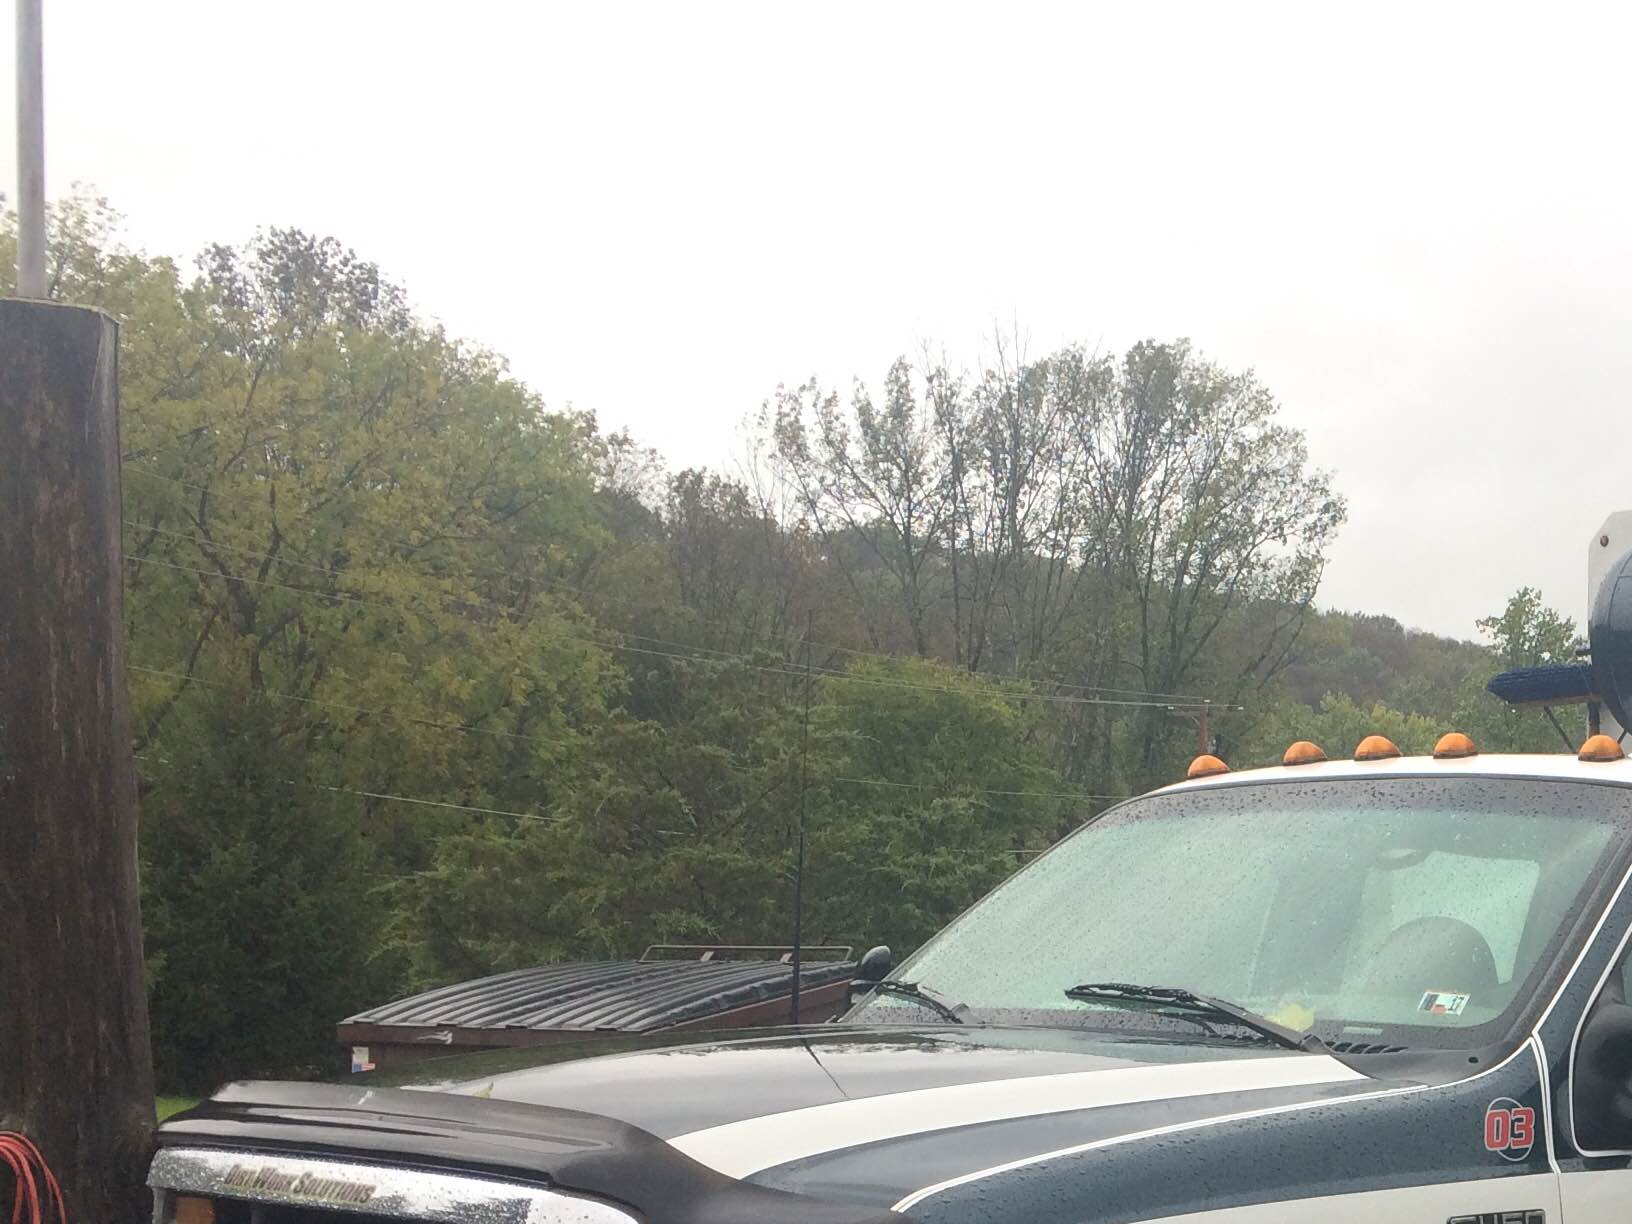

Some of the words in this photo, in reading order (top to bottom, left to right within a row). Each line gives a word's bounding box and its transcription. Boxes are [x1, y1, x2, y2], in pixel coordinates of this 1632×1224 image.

[1484, 1107, 1535, 1150] 03
[224, 1164, 258, 1187] DIRT
[252, 1165, 299, 1192] WORK
[293, 1171, 376, 1203] SOLUTIONS
